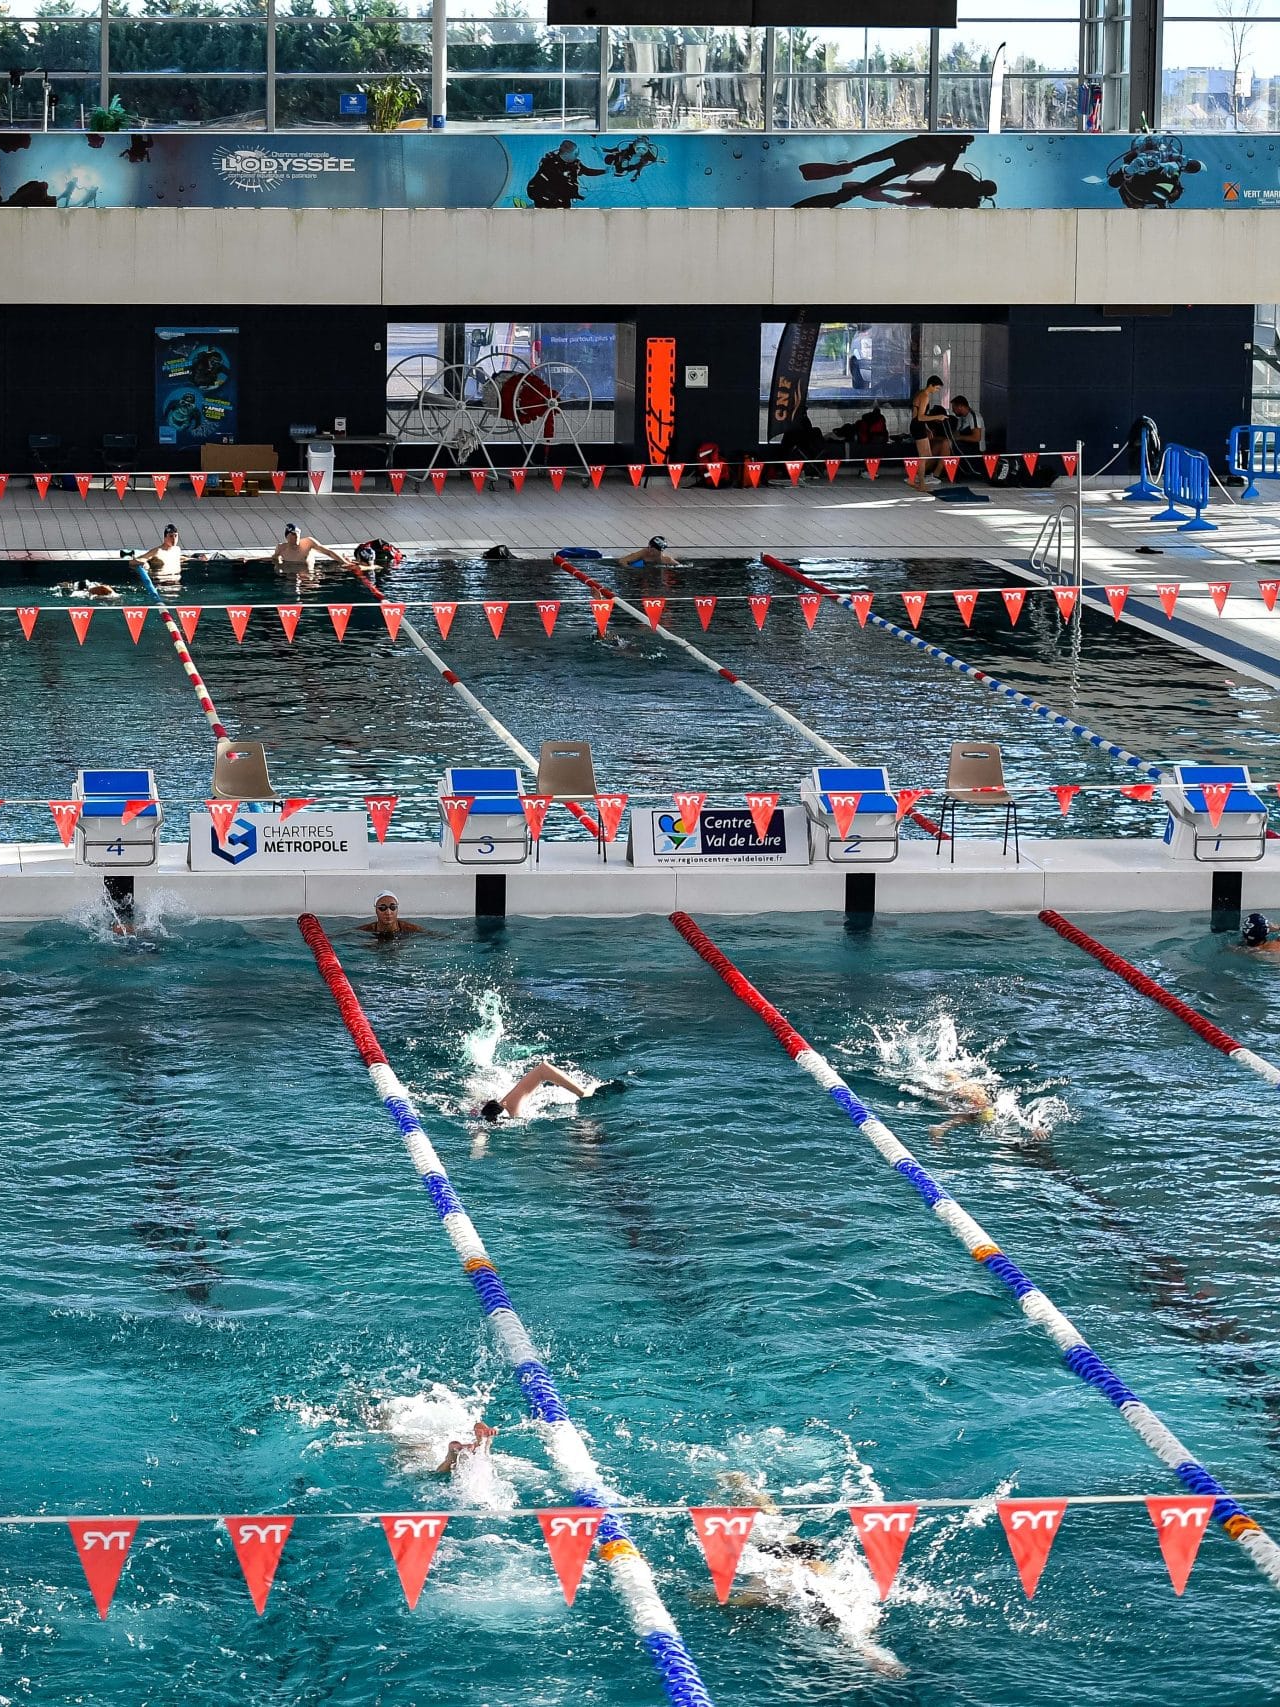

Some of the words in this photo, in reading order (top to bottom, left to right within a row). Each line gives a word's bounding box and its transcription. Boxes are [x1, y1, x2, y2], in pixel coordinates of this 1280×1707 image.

[1244, 190, 1261, 198] VERT
[445, 800, 467, 809] TYR
[523, 800, 545, 809] TYR
[598, 798, 621, 807] TYR
[677, 796, 699, 805] TYR
[749, 797, 771, 806] TYR
[832, 797, 854, 806] TYR
[53, 805, 76, 814] TYR
[209, 804, 232, 813] TYR
[368, 801, 390, 810] TYR
[263, 826, 334, 838] CHARTRES
[705, 834, 726, 847] Val
[728, 833, 745, 846] de
[749, 834, 782, 846] Loire
[844, 834, 862, 853] 2
[107, 838, 125, 856] 4
[264, 838, 348, 852] MÉTROPOLE
[477, 836, 495, 854] 3
[658, 855, 783, 864] www.regioncentre-valdeloire.fr
